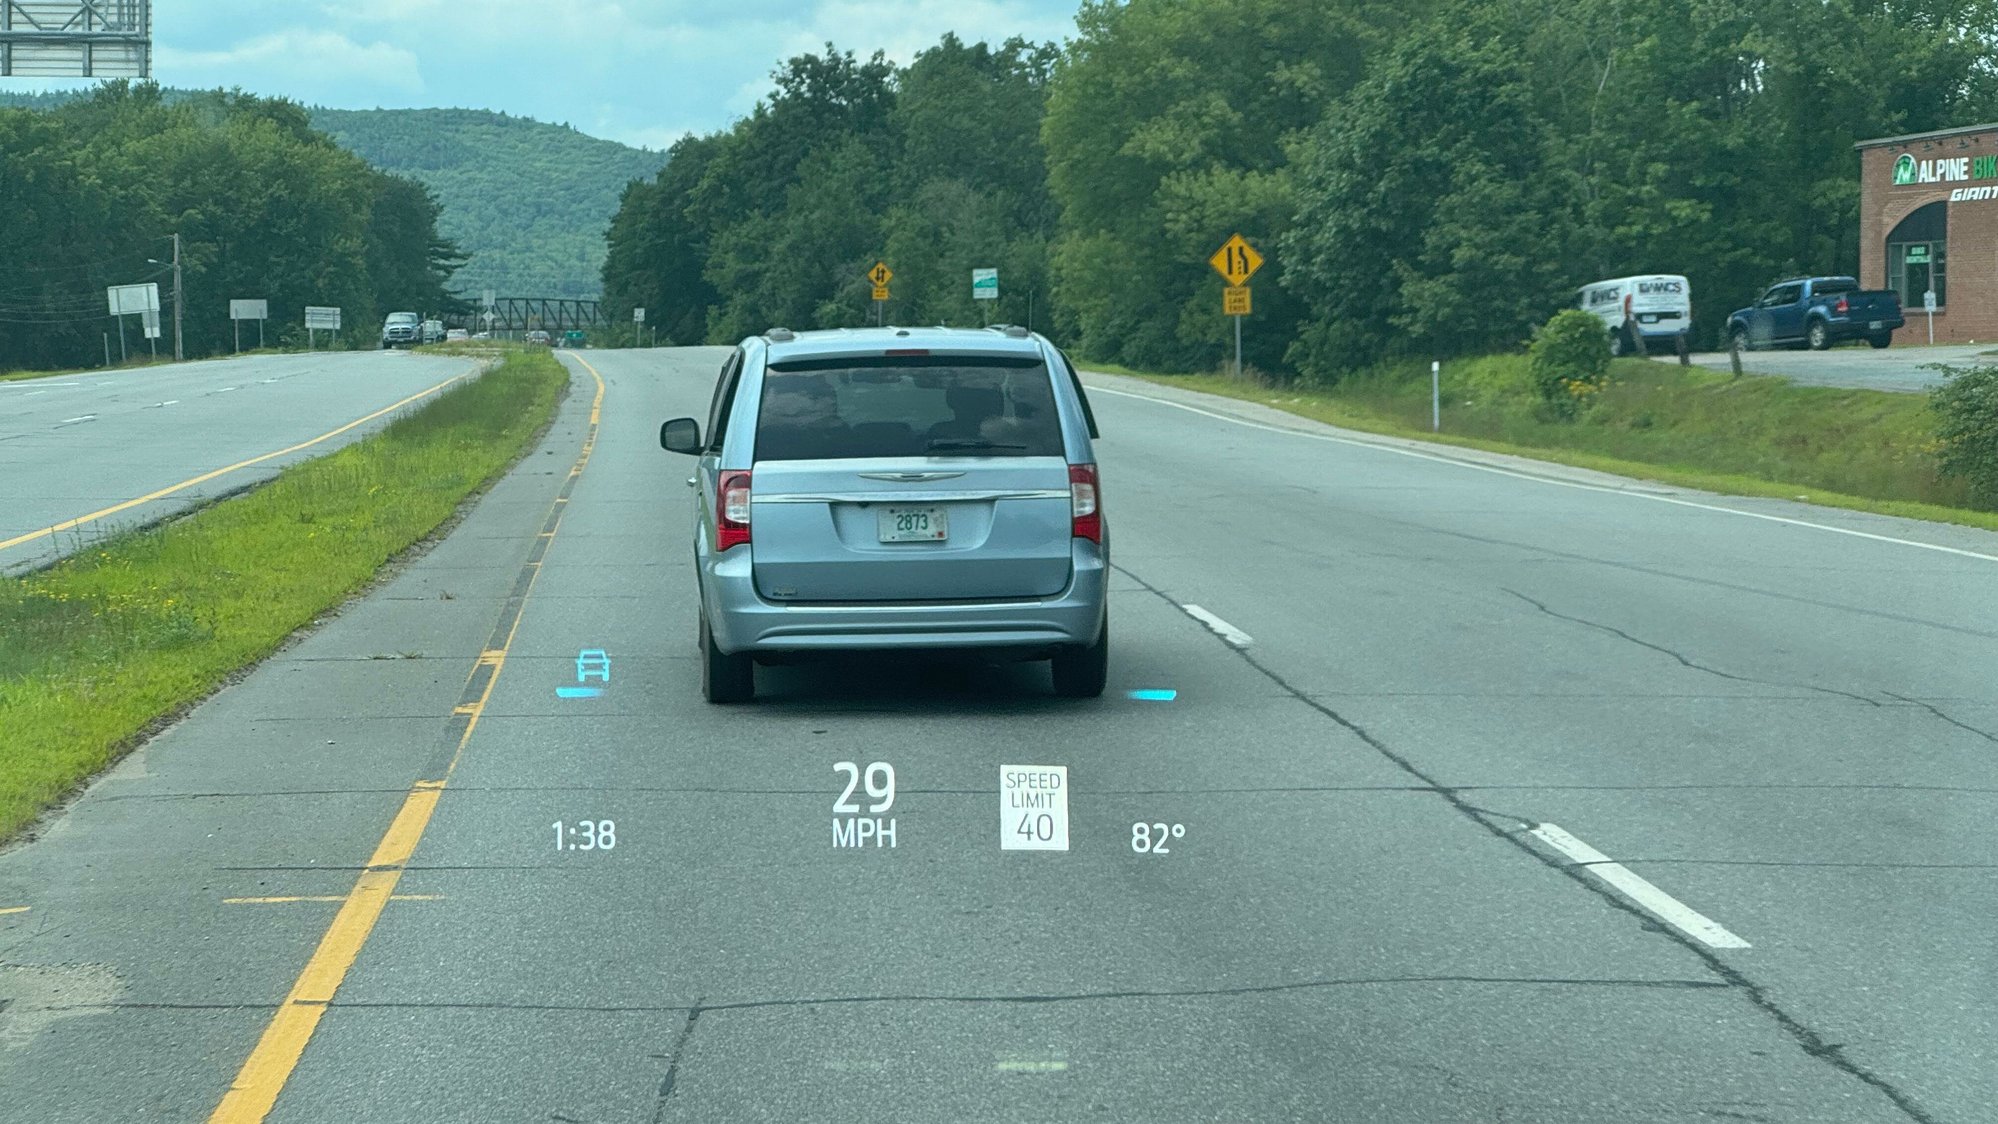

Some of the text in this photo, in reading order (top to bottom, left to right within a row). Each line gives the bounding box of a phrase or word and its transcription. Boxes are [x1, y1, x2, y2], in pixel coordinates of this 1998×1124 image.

[1918, 157, 1969, 183] ALPINE
[1228, 304, 1247, 312] ENDS
[897, 514, 928, 531] 2873
[833, 761, 896, 813] 29
[1006, 772, 1061, 790] SPEED
[1011, 792, 1056, 809] LIMIT
[552, 820, 616, 850] 1:38
[832, 818, 897, 848] MPH
[1017, 814, 1054, 841] 40
